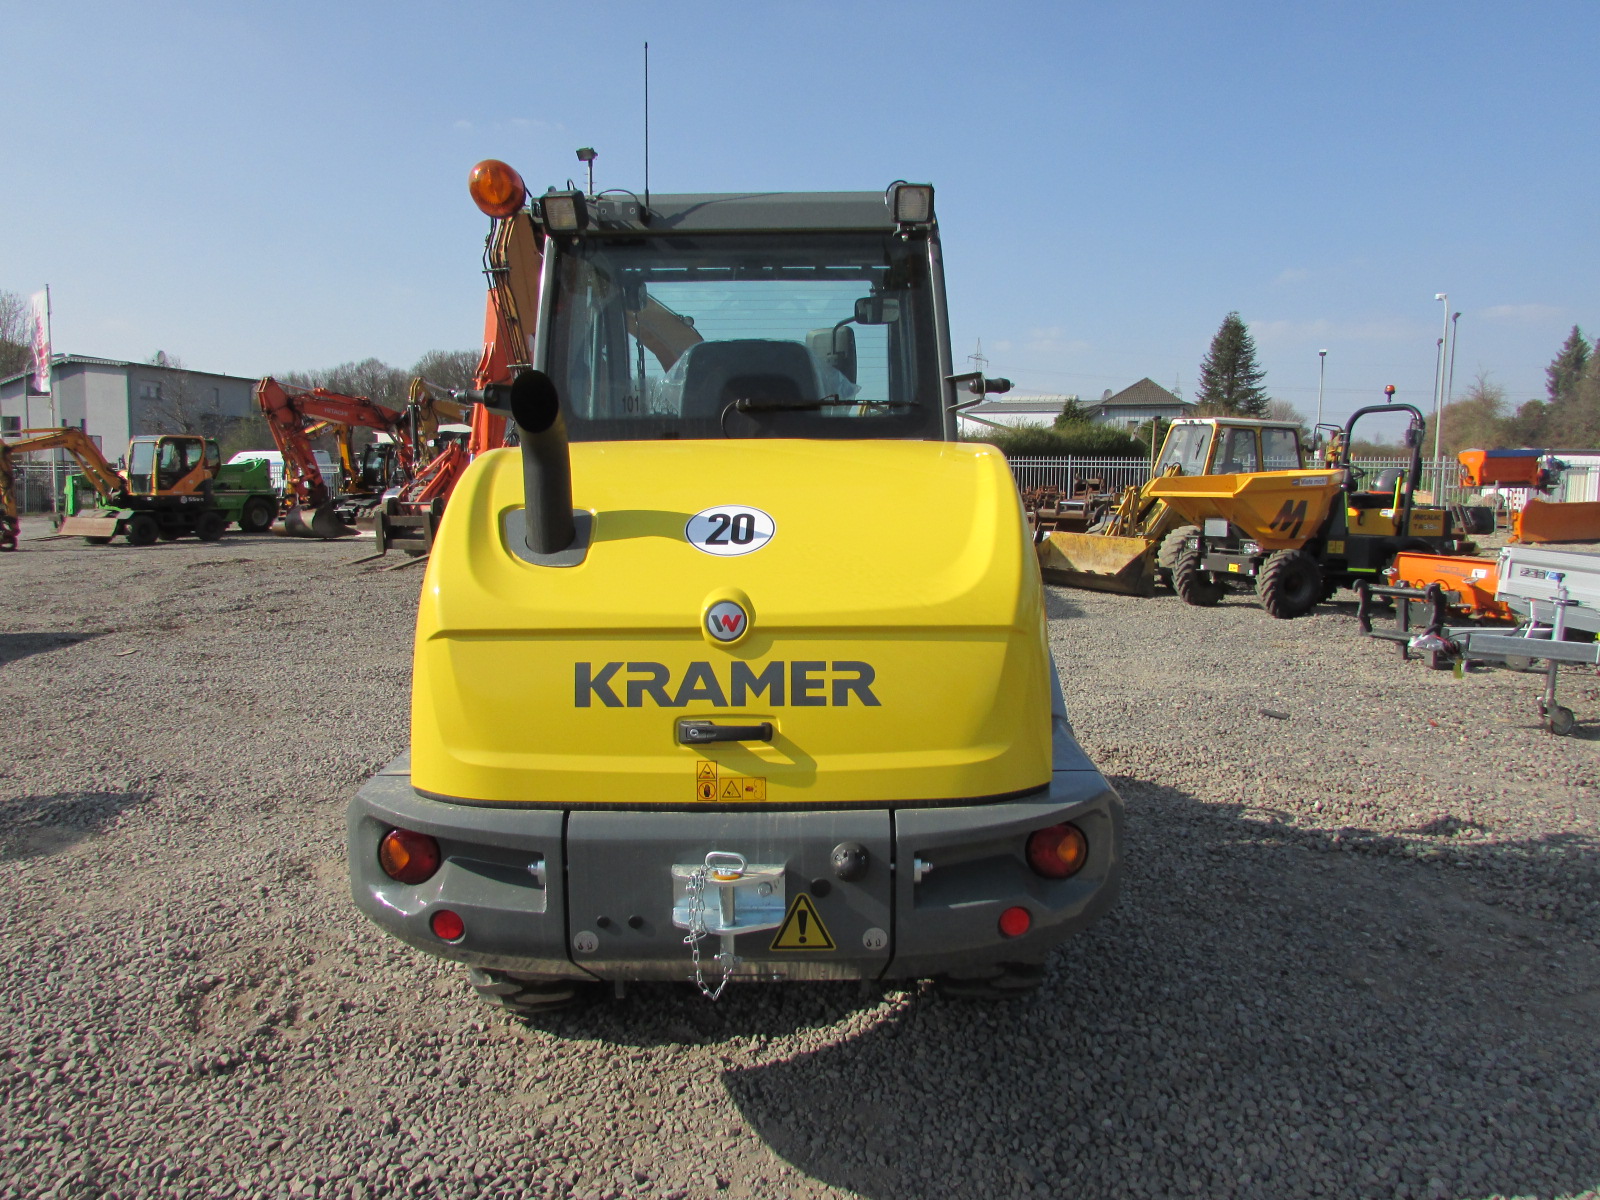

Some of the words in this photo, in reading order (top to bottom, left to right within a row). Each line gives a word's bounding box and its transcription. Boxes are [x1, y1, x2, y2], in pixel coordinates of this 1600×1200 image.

[324, 407, 349, 417] HITACHI
[621, 395, 639, 413] 101
[705, 513, 755, 545] 20
[1269, 499, 1308, 539] M
[574, 660, 882, 708] KRAMER
